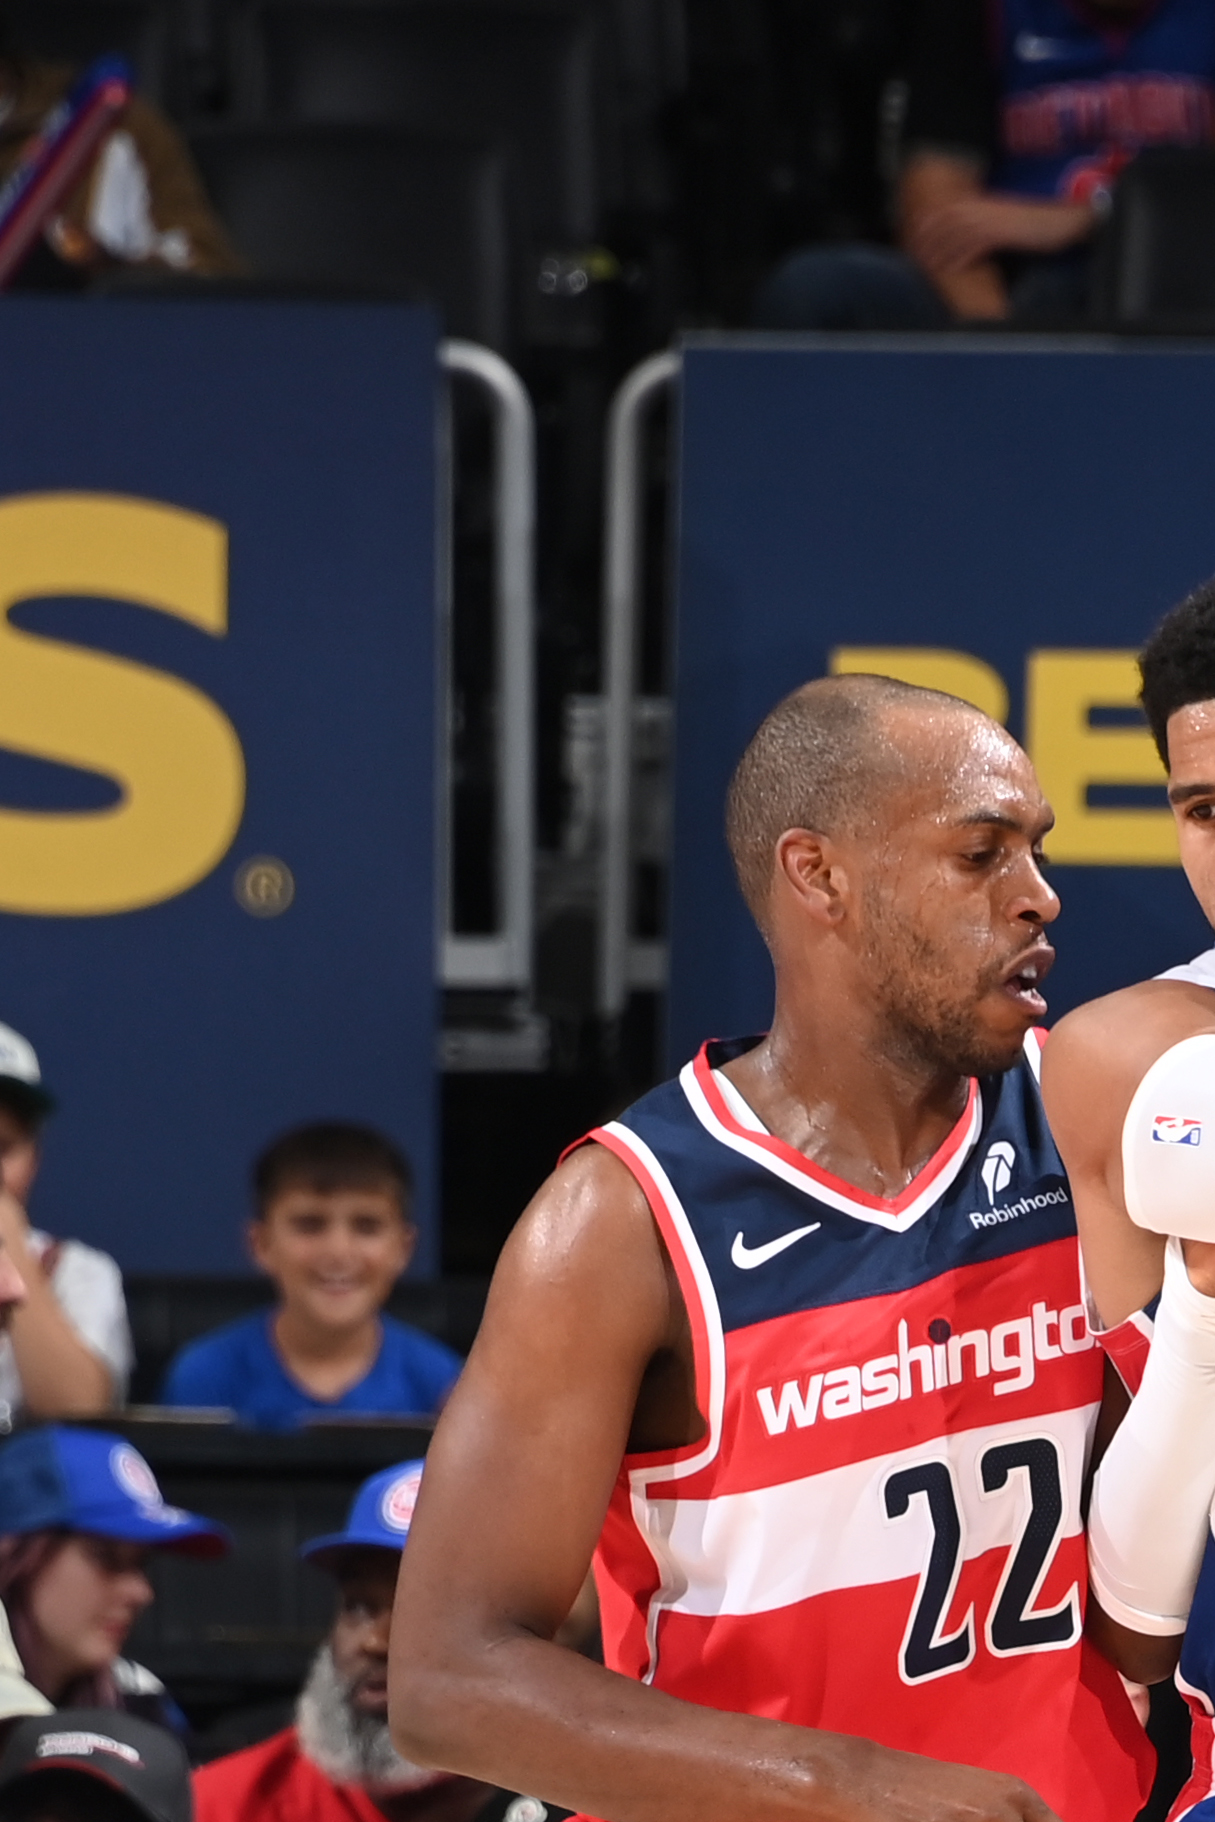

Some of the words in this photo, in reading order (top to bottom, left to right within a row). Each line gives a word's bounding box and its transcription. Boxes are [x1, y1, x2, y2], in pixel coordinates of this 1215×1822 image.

[969, 1187, 1069, 1230] Robinhood
[756, 1301, 1101, 1436] washingto
[878, 1432, 1083, 1686] 22
